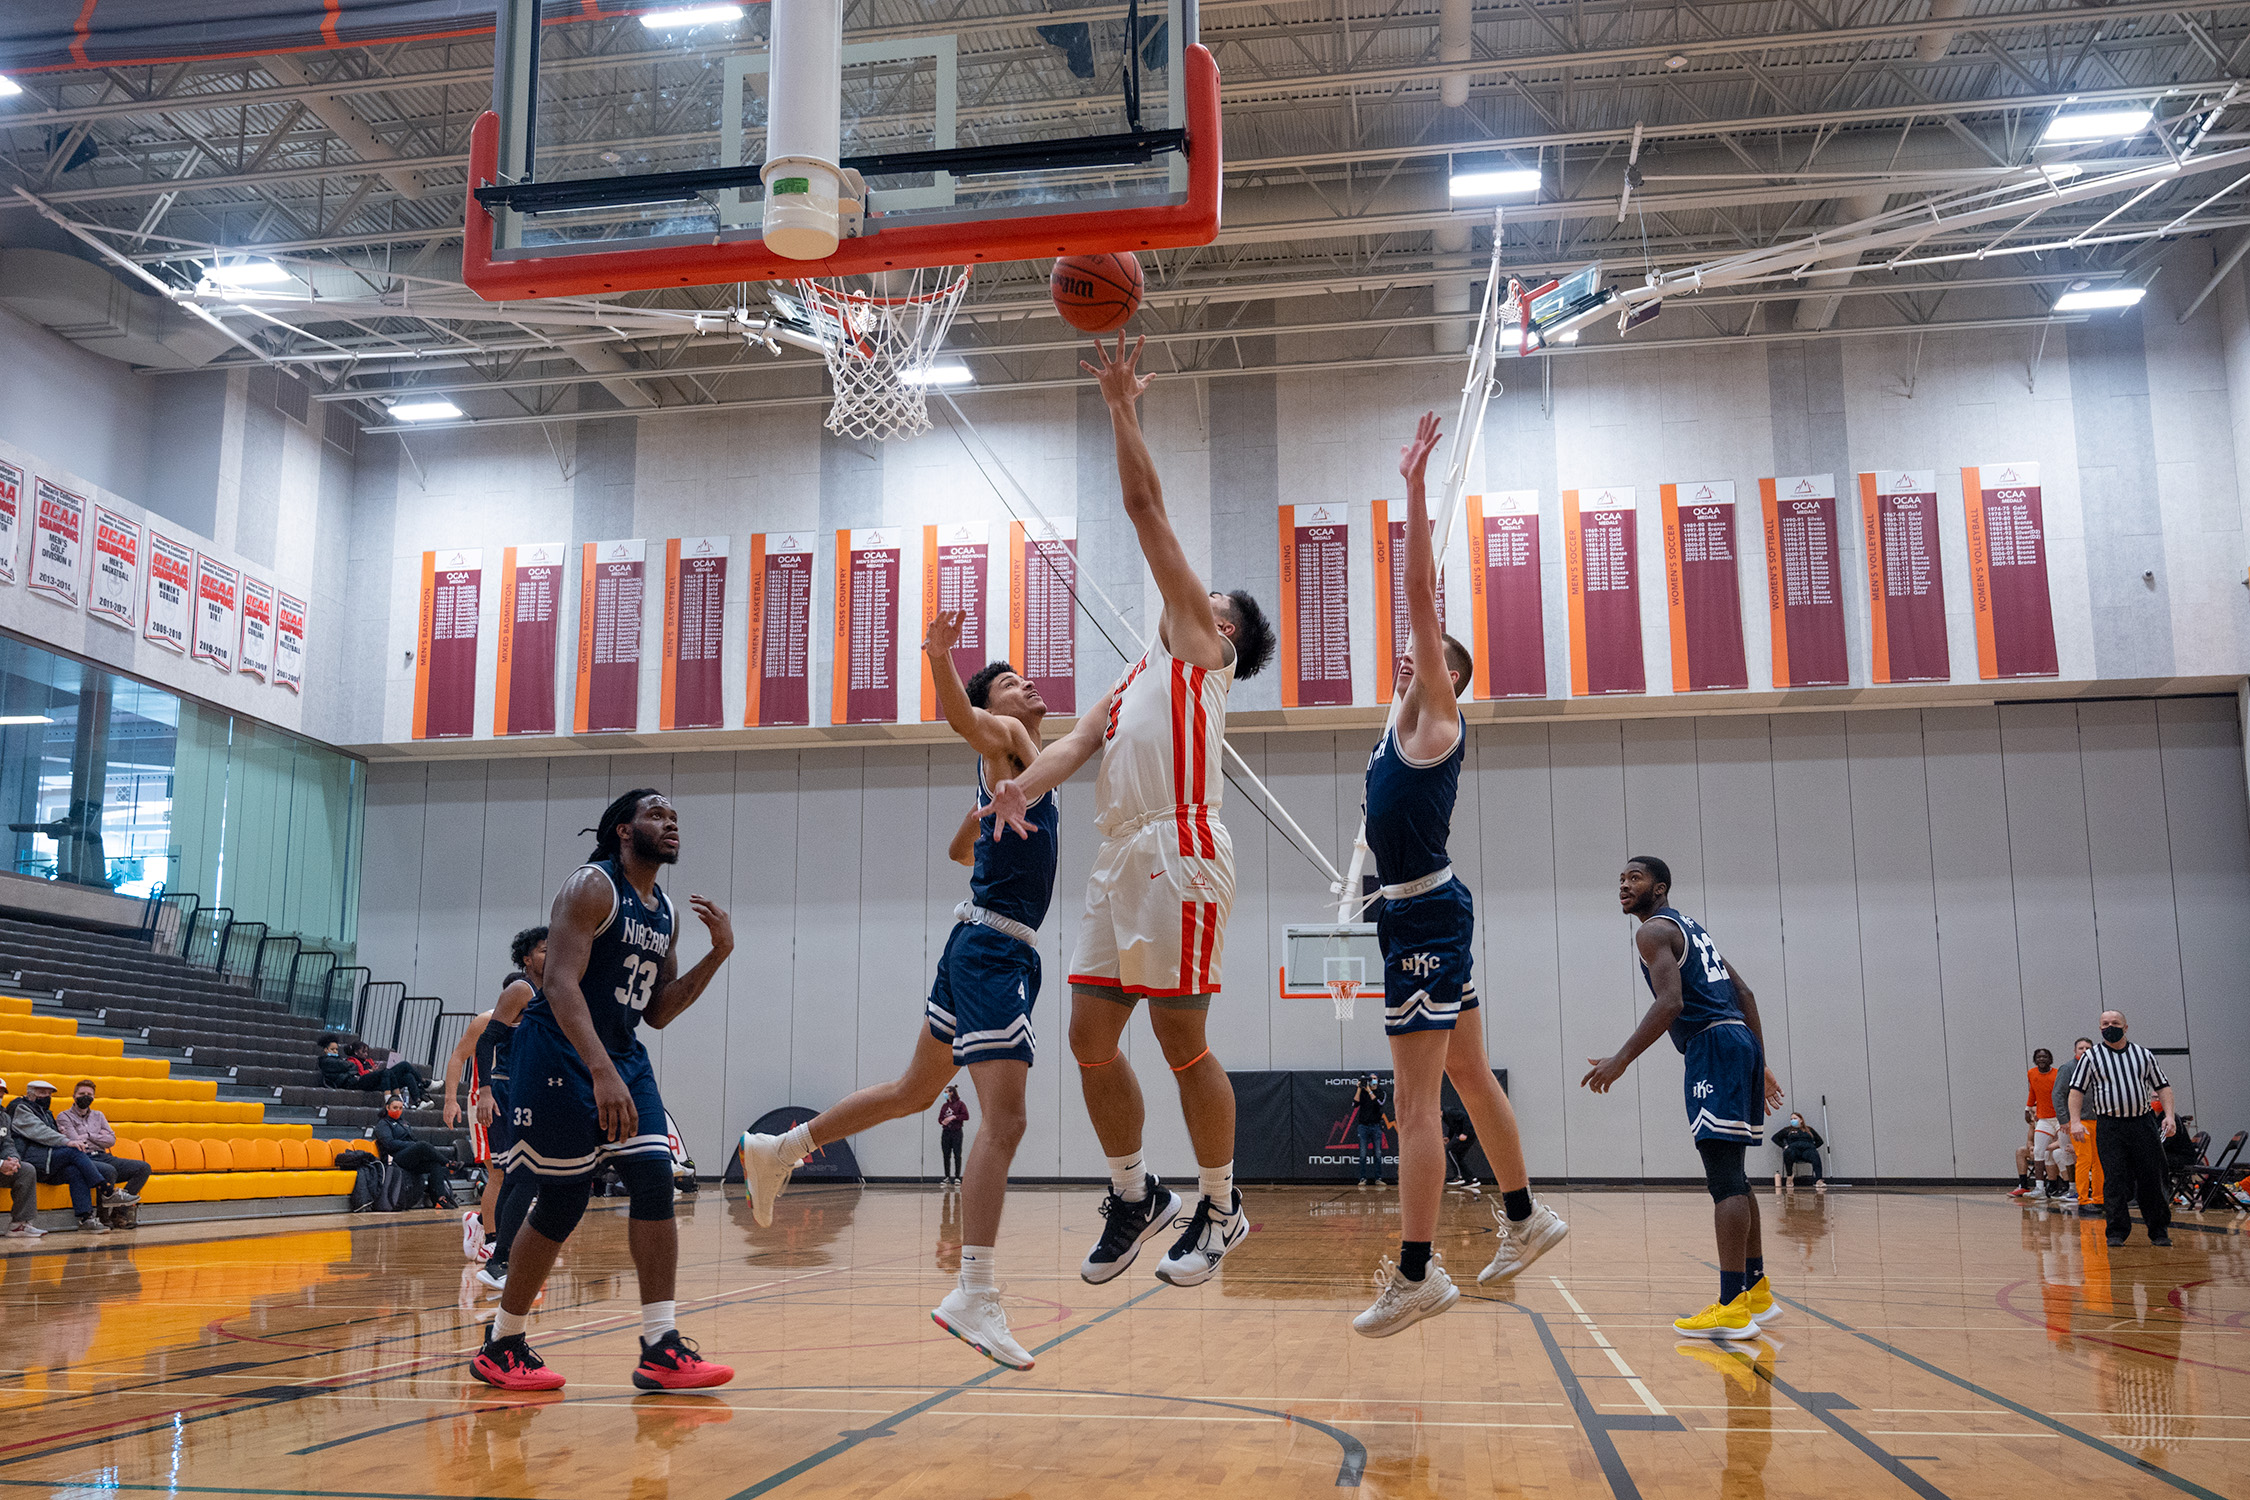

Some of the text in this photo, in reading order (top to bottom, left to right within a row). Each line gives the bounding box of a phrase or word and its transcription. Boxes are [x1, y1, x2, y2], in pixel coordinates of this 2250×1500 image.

[1893, 496, 1921, 504] OCAA
[1997, 490, 2026, 499] OCAA
[40, 500, 78, 529] OCAA
[1594, 512, 1622, 520] OCAA
[1693, 507, 1720, 516] OCAA
[1792, 502, 1820, 510] OCAA
[39, 516, 78, 544] CHAMPIONS
[1498, 517, 1524, 526] OCAA
[49, 534, 68, 548] MEN'S
[98, 524, 136, 552] OCAA
[1308, 528, 1334, 536] OCAA
[42, 548, 66, 565] DIVISION
[50, 543, 65, 554] GOLF
[97, 538, 136, 566] CHAMPIONS
[950, 547, 976, 555] OCAA
[1866, 514, 1879, 600] MEN'S VOLLEYBALL
[109, 557, 124, 570] MEN'S
[153, 552, 188, 578] OCAA
[608, 564, 632, 572] OCAA
[692, 560, 716, 568] OCAA
[1284, 544, 1292, 582] CURLING
[1472, 535, 1482, 594] MEN'S RUGBY
[1569, 530, 1578, 594] MEN'S SOCCER
[1668, 524, 1679, 606] WOMEN'S SOCCER
[1766, 519, 1779, 610] WOMEN'S SOFTBALL
[1971, 508, 1986, 612] WOMEN'S VOLLEYBALL
[39, 572, 70, 591] 2013-2014
[102, 564, 128, 581] BASKETBALL
[152, 565, 188, 591] CHAMPIONS
[446, 572, 469, 580] OCAA
[528, 568, 551, 576] OCAA
[159, 581, 180, 596] WOMEN'S
[201, 574, 234, 598] OCAA
[926, 564, 934, 604] COUNTRY
[160, 590, 178, 604] CURLING
[200, 586, 234, 612] CHAMPIONS
[246, 594, 270, 614] OCAA
[583, 580, 592, 630] BADMINTON
[754, 572, 762, 622] BASKETBALL
[209, 603, 223, 614] RUGBY
[245, 606, 270, 626] CHAMPIONS
[503, 584, 512, 634] BADMINTON
[666, 576, 676, 658] MEN'S BASKETBALL
[280, 610, 302, 628] OCAA
[420, 588, 430, 666] MEN'S BADMINTON
[838, 610, 846, 637] CROSS
[152, 622, 182, 640] 2009-2010
[248, 628, 264, 640] CURLING
[284, 634, 296, 644] MEN'S
[1401, 952, 1440, 979] NKC
[1692, 932, 1730, 983] 22
[614, 953, 658, 1011] 33
[513, 1107, 533, 1127] 33
